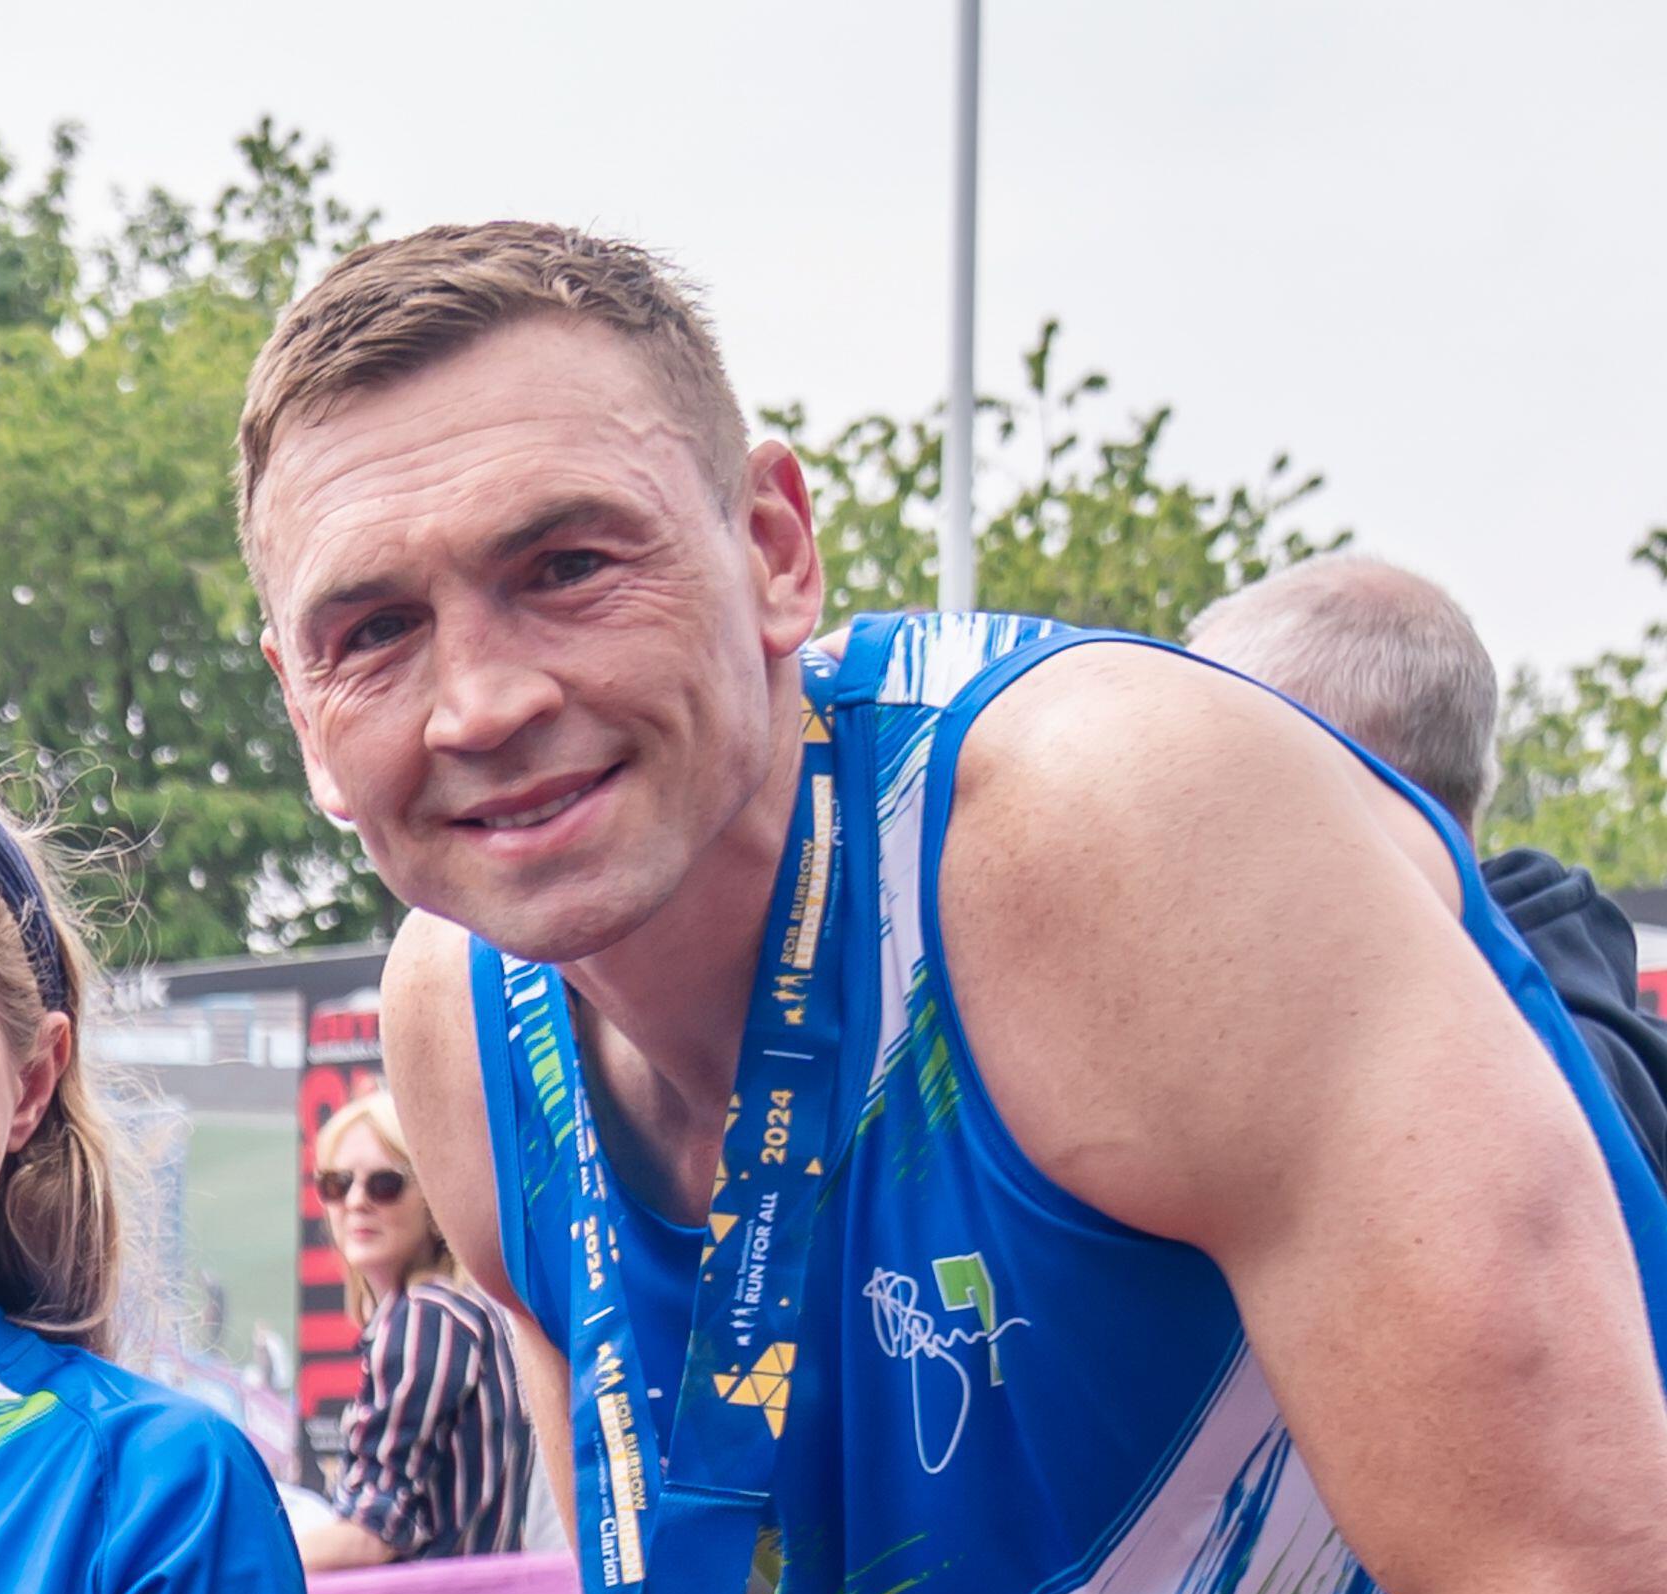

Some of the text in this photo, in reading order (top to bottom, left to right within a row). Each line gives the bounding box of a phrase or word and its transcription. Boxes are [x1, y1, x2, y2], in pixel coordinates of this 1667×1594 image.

[760, 1088, 794, 1166] 2024
[582, 1215, 605, 1291] 2024
[744, 1191, 779, 1305] RUN FOR ALL
[599, 1517, 619, 1589] Clarion
